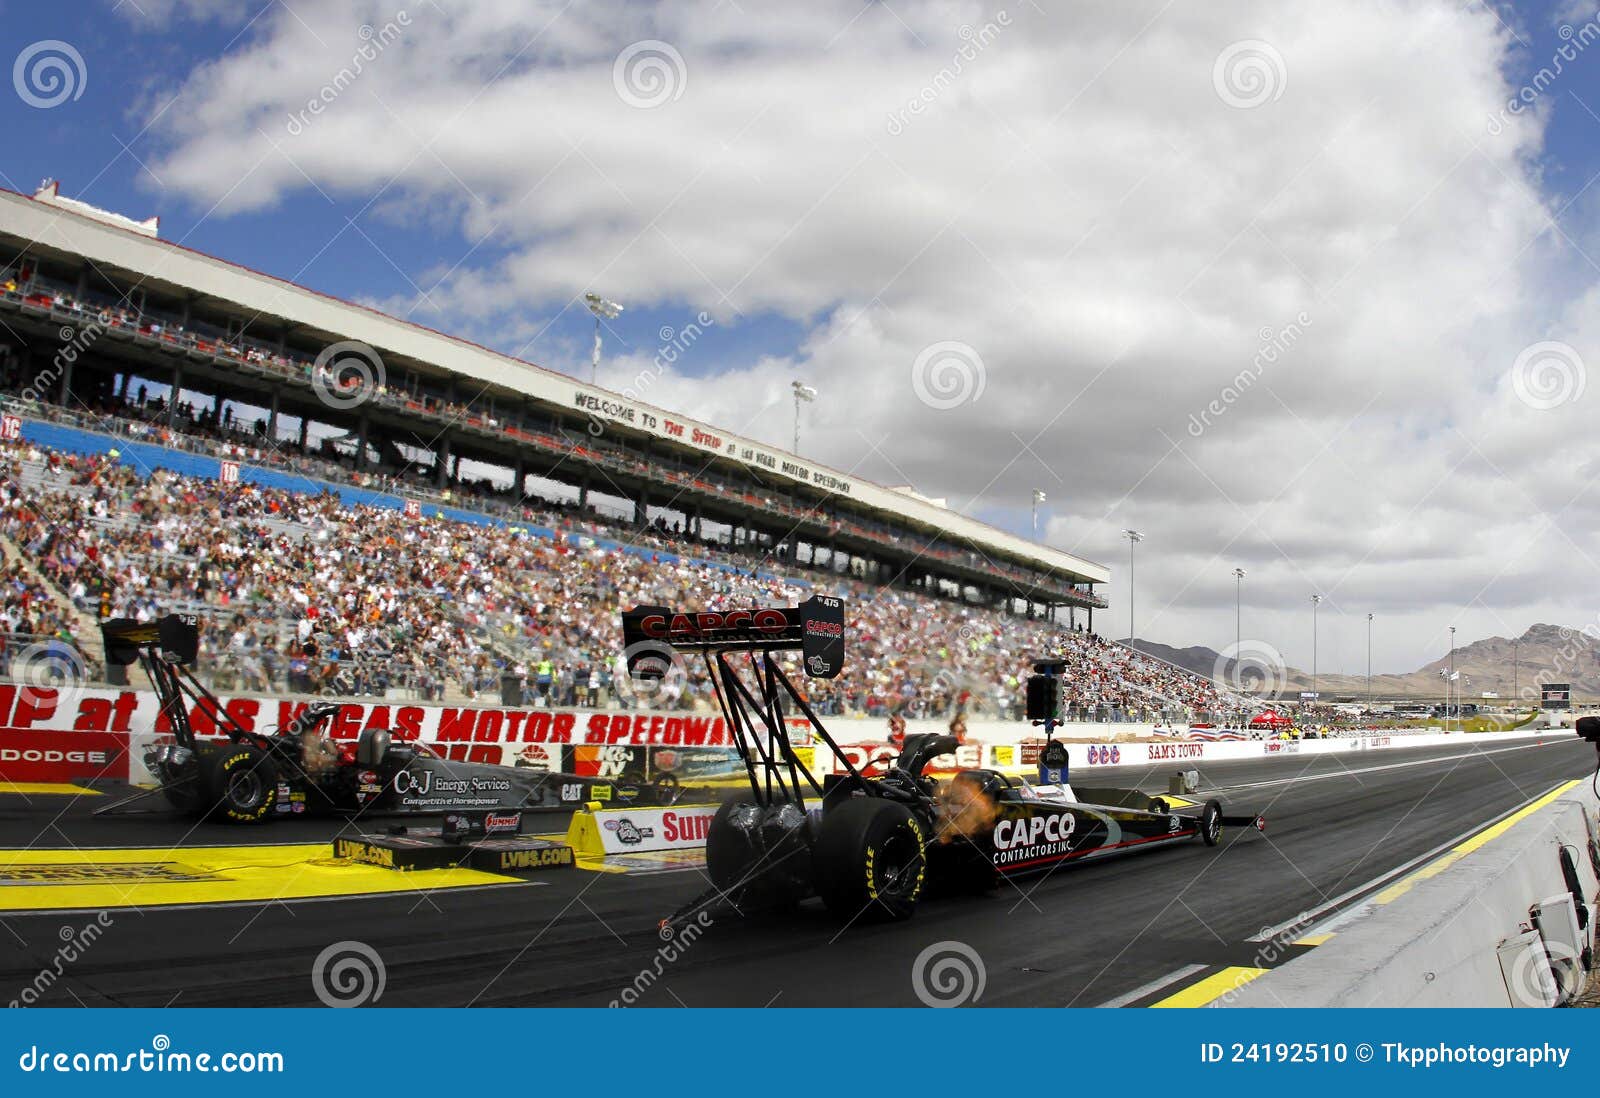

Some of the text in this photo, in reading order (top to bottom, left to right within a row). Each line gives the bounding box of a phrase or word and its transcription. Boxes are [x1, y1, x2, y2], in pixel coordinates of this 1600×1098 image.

[575, 391, 634, 422] WELCOME
[642, 413, 657, 429] TO
[663, 419, 685, 437] THE
[692, 428, 722, 449] STRIP
[781, 461, 809, 480] MOTOR
[813, 472, 850, 493] SPEEDWAY
[824, 599, 839, 608] 475
[186, 615, 197, 626] 12
[641, 610, 788, 637] CAPCO
[806, 620, 841, 635] CAPCO
[73, 692, 138, 732] at
[278, 700, 425, 741] VGAS
[437, 708, 575, 744] MOTOR
[585, 714, 737, 746] SPEEDWA
[1, 749, 107, 764] DODGE
[224, 752, 250, 771] EAGLE
[834, 744, 980, 772] DOGE
[1149, 744, 1204, 760] SAM'S TOWN
[394, 770, 432, 795] C&J
[436, 778, 469, 796] Energy
[471, 777, 510, 792] Services
[562, 783, 582, 801] CAT
[402, 796, 500, 807] Competitive Horsepower
[993, 812, 1076, 850] CAPCO
[338, 839, 394, 867] LVMS.COM
[501, 848, 572, 869] LVMS.COM
[993, 842, 1056, 864] CONTRACTORS
[866, 846, 878, 900] EAGLE
